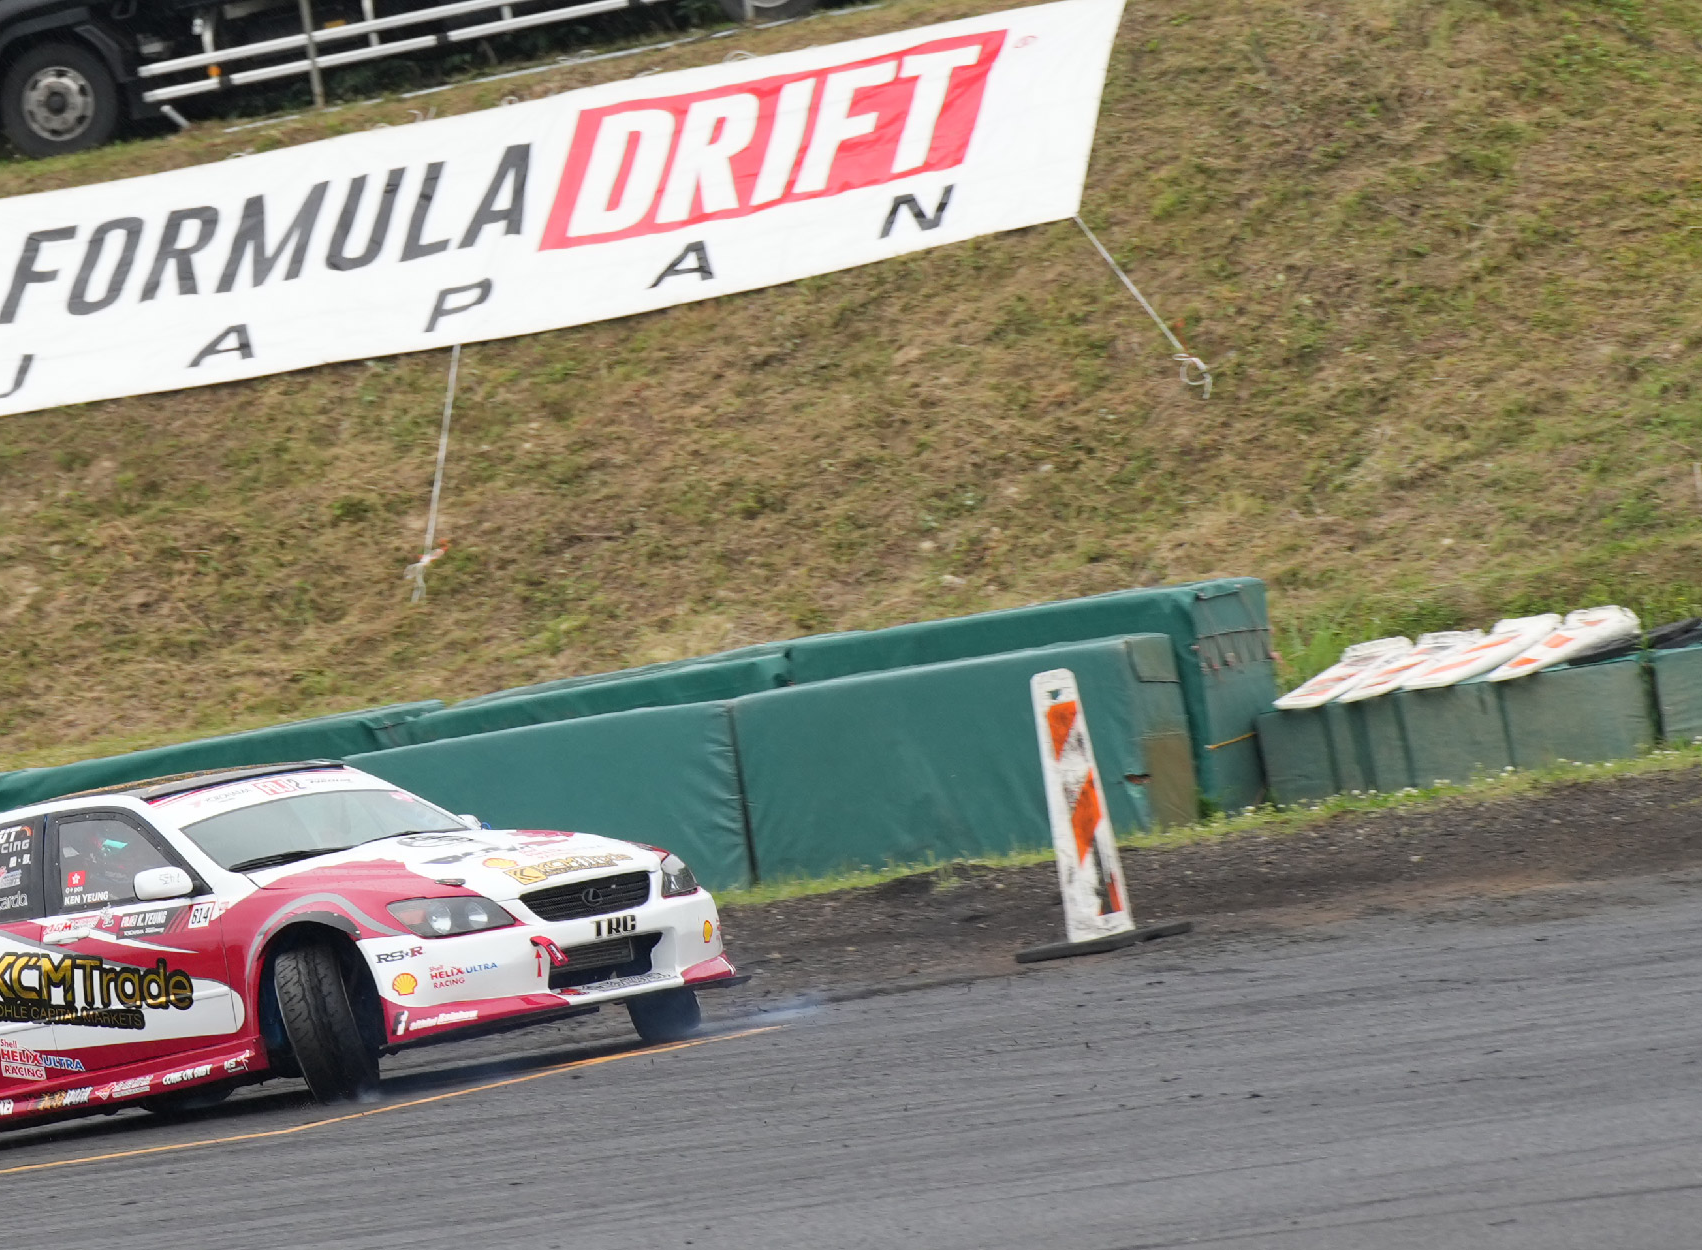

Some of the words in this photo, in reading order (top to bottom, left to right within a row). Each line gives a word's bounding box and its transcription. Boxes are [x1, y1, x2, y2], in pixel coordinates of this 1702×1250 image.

[565, 44, 984, 238] DRIFT
[64, 895, 81, 906] KEN
[81, 890, 109, 904] YEUNG
[191, 906, 211, 926] 614
[430, 966, 465, 981] HELIX
[465, 962, 498, 974] ULTRA
[433, 977, 466, 989] RACING
[0, 1039, 18, 1049] Shell
[0, 1048, 42, 1066] HELIX
[42, 1054, 86, 1072] ULTRA
[3, 1064, 45, 1080] RACING
